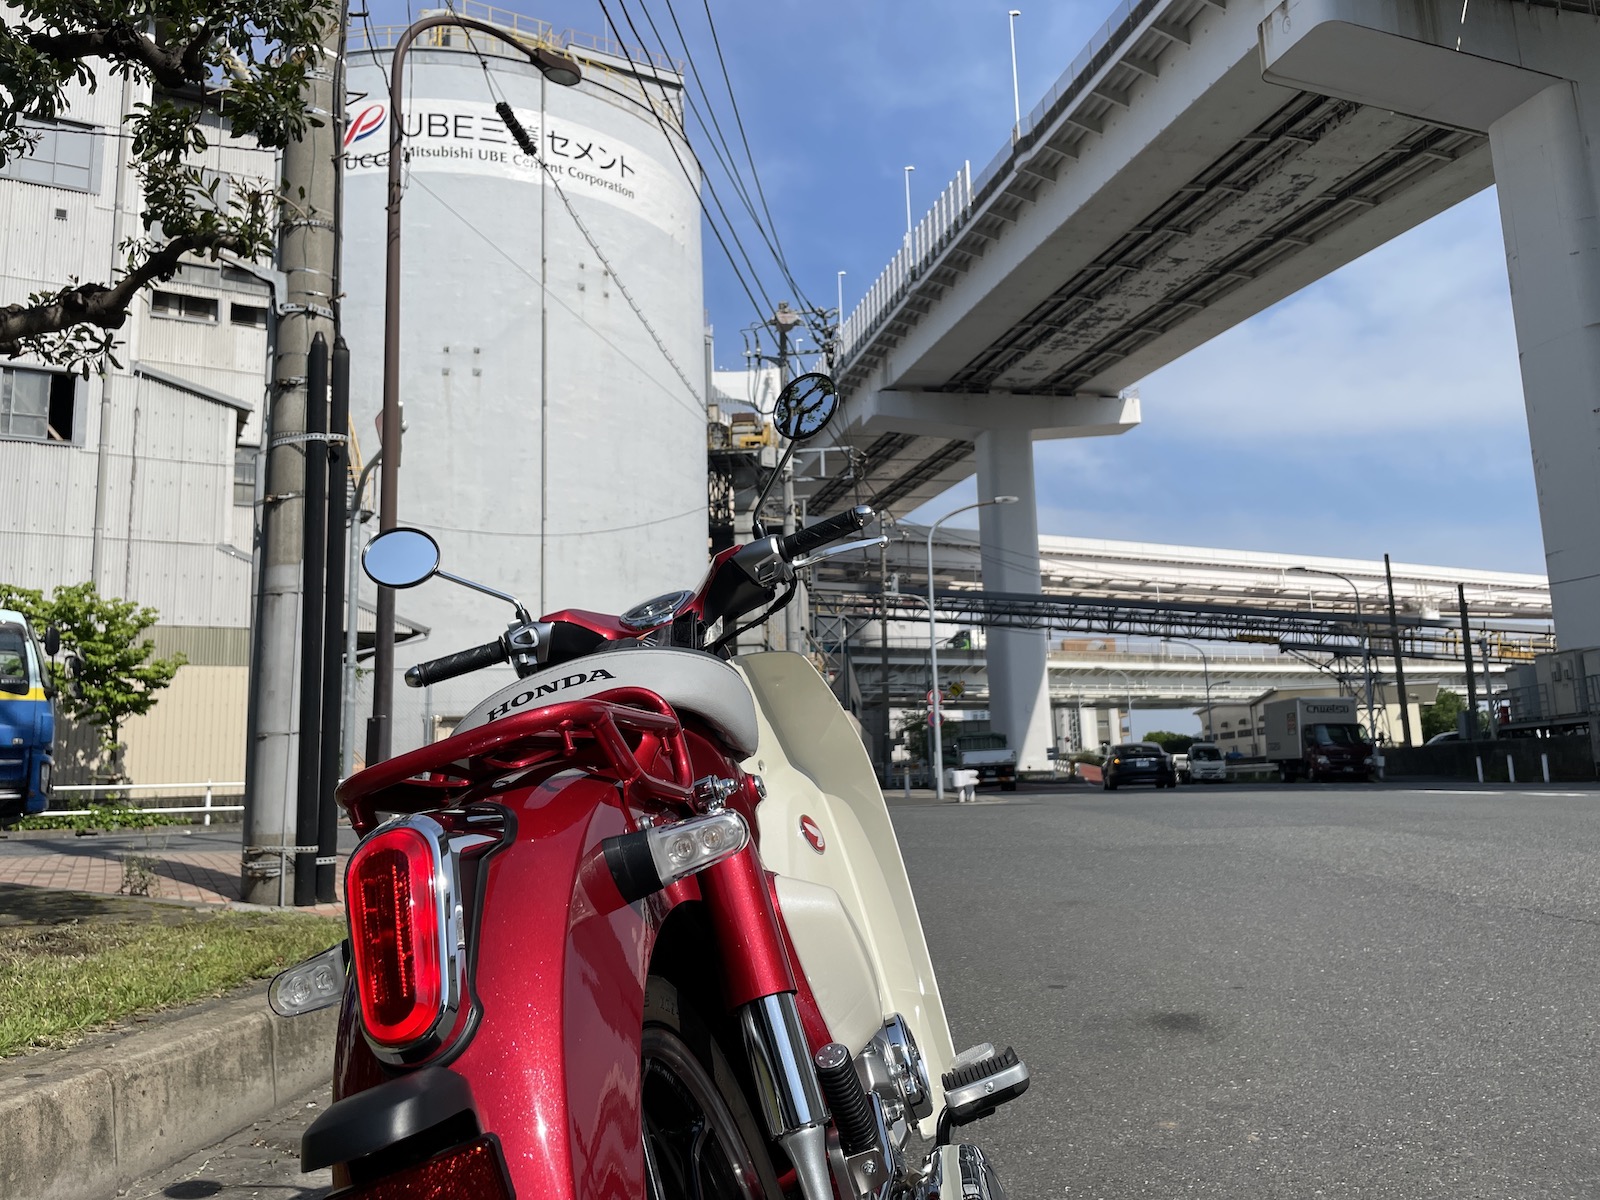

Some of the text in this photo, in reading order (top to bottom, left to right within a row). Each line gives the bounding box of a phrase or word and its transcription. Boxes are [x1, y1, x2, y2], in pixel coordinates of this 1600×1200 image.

[401, 112, 635, 178] UBE三セメント
[402, 145, 473, 159] Mitsubishi
[478, 149, 508, 164] UBE
[568, 166, 635, 200] Corporation
[487, 669, 617, 724] HONDA
